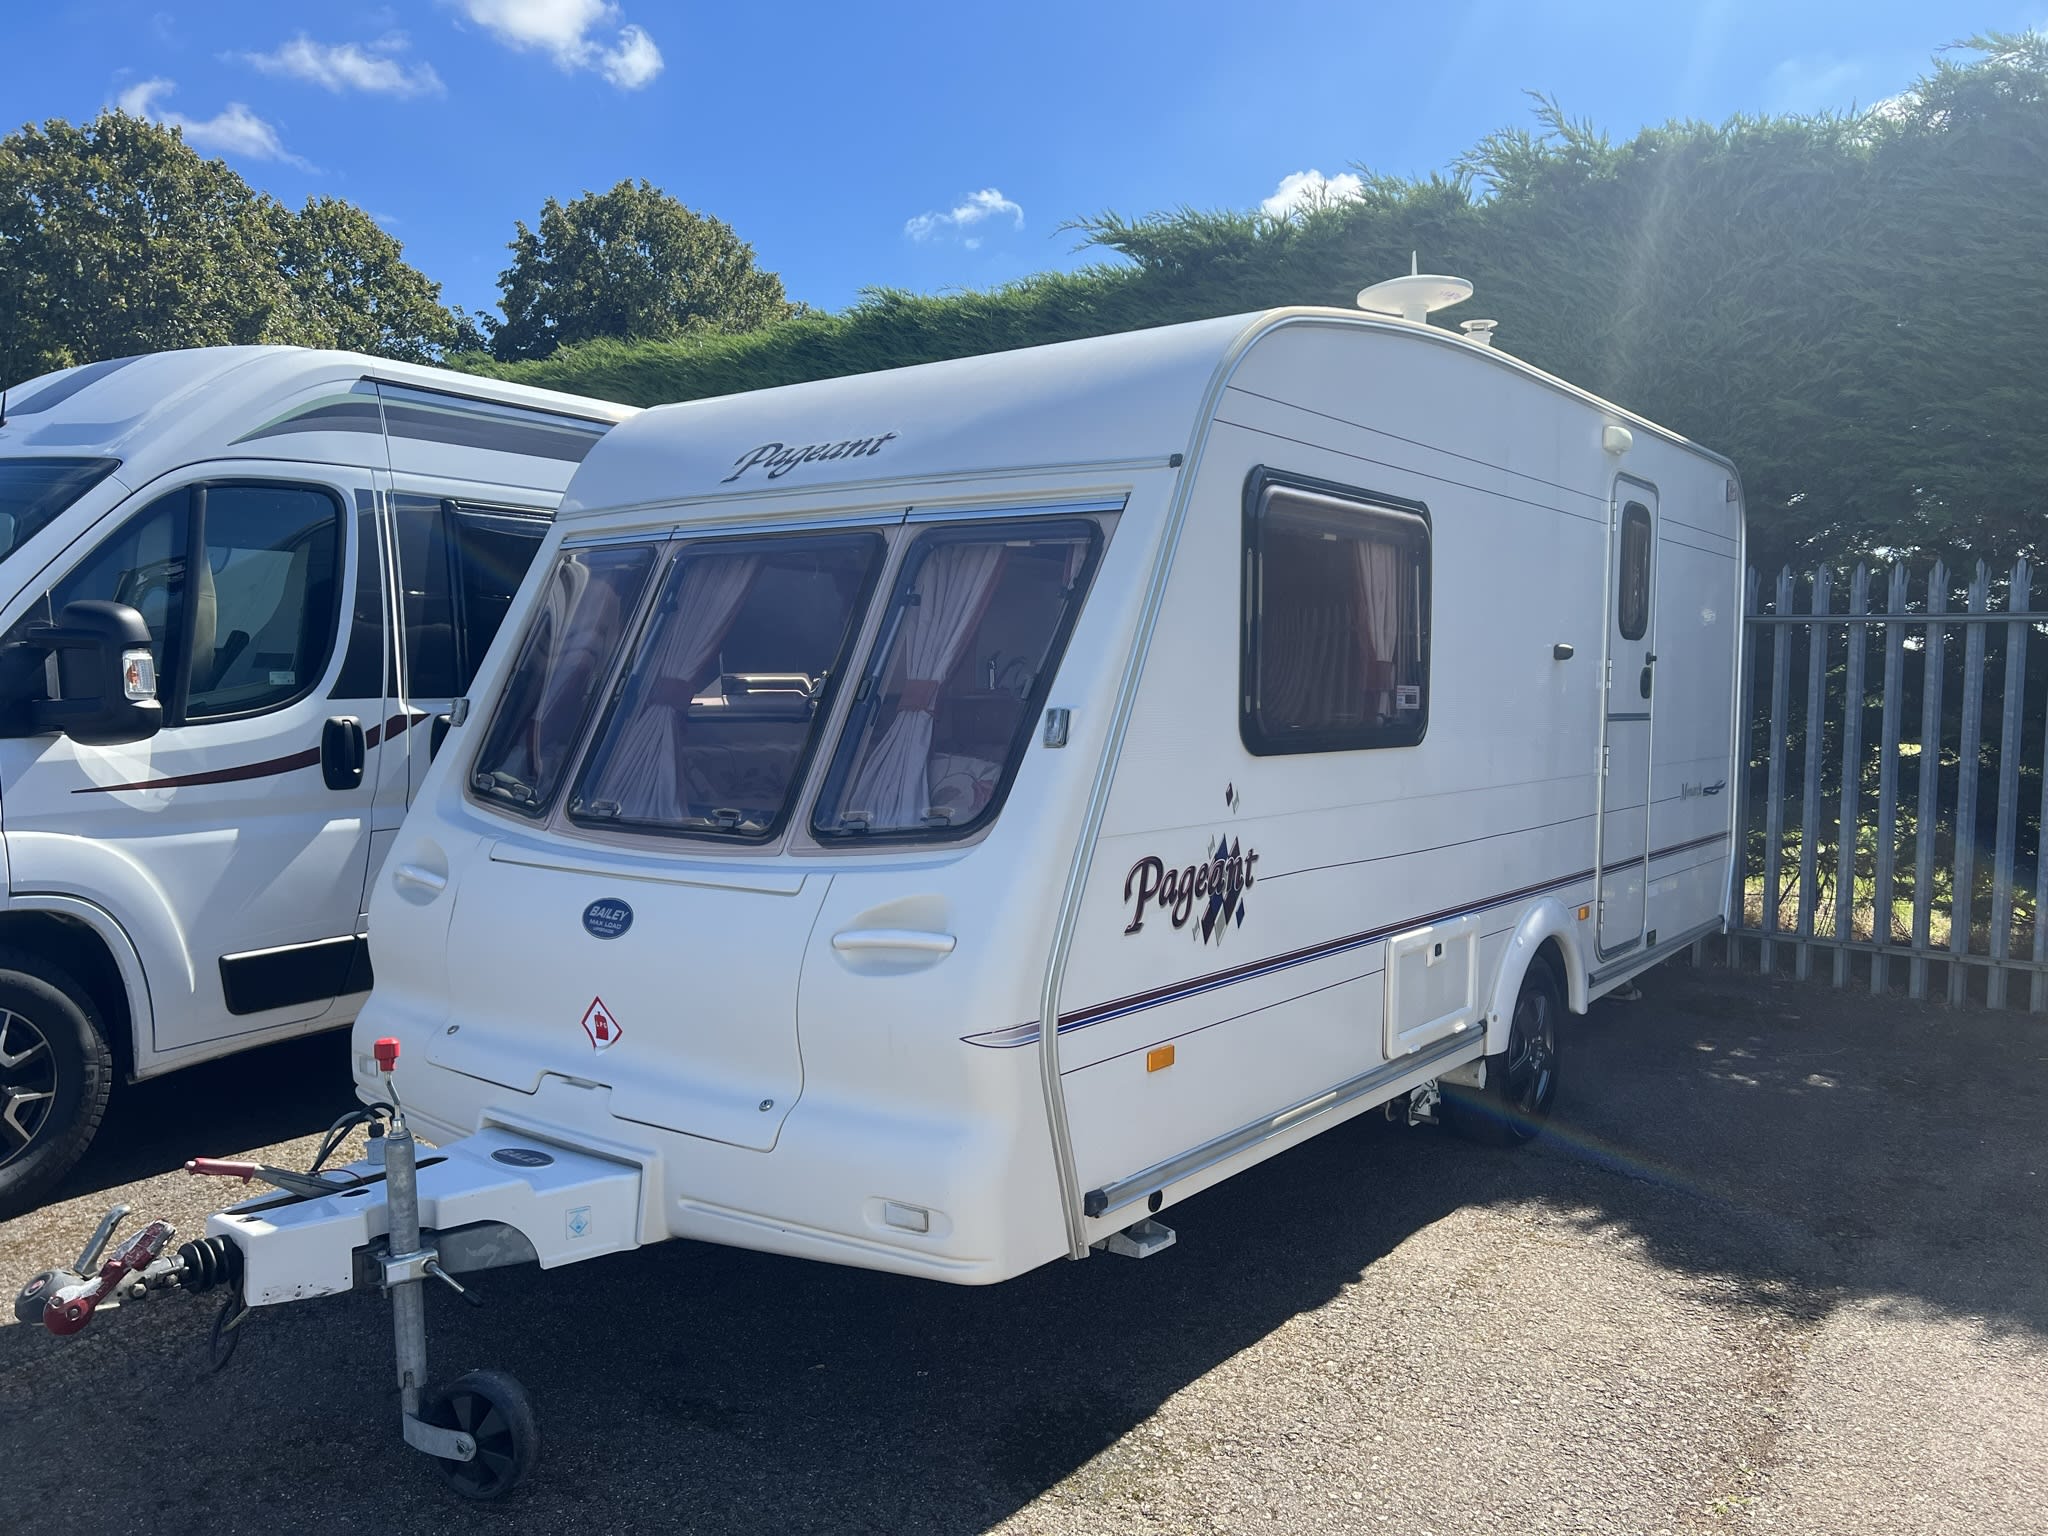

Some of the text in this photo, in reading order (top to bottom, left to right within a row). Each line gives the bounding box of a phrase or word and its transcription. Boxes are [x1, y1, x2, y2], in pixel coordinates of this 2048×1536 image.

[720, 432, 896, 483] Pageant
[1124, 848, 1259, 935] Pageant
[589, 906, 629, 921] BAILEY
[604, 921, 622, 929] LOAD
